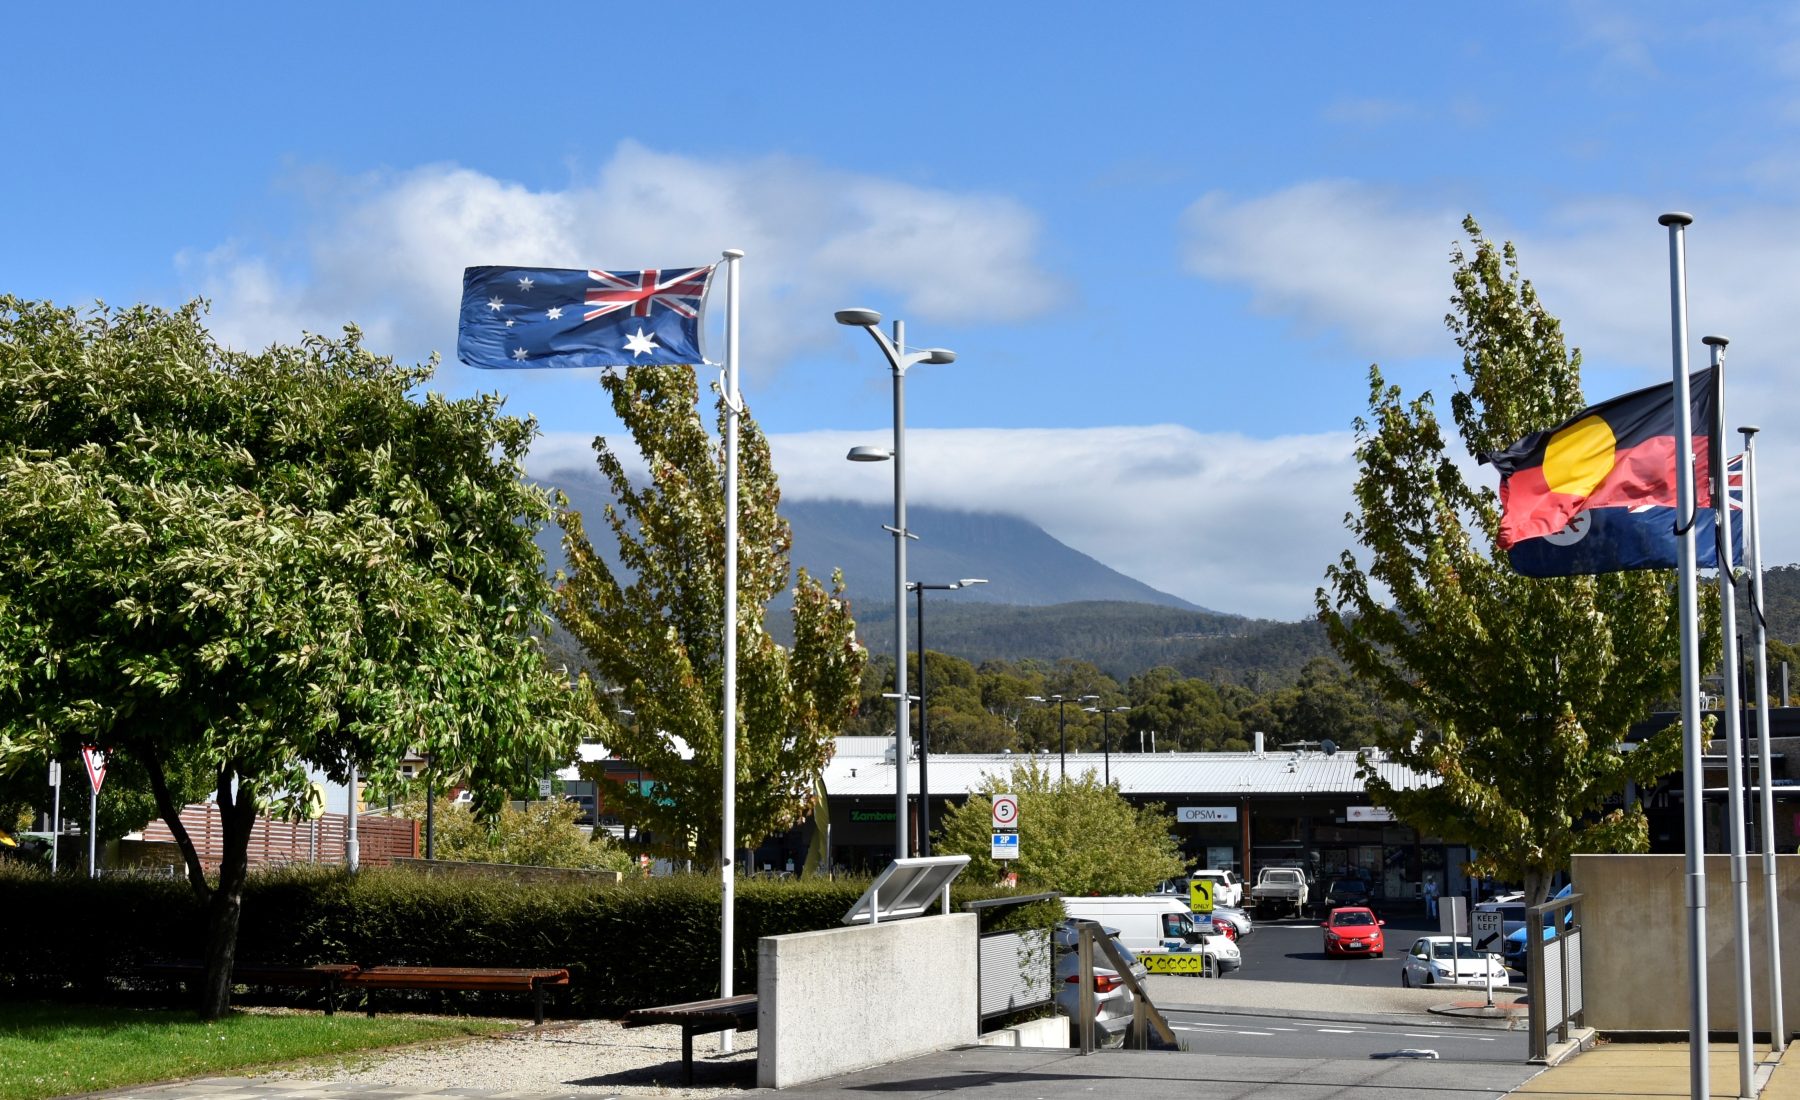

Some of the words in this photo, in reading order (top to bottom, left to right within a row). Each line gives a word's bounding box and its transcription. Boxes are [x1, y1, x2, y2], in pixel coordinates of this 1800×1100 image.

[1002, 805, 1009, 816] 5
[1185, 810, 1216, 819] OPSM
[1000, 835, 1010, 844] 2P
